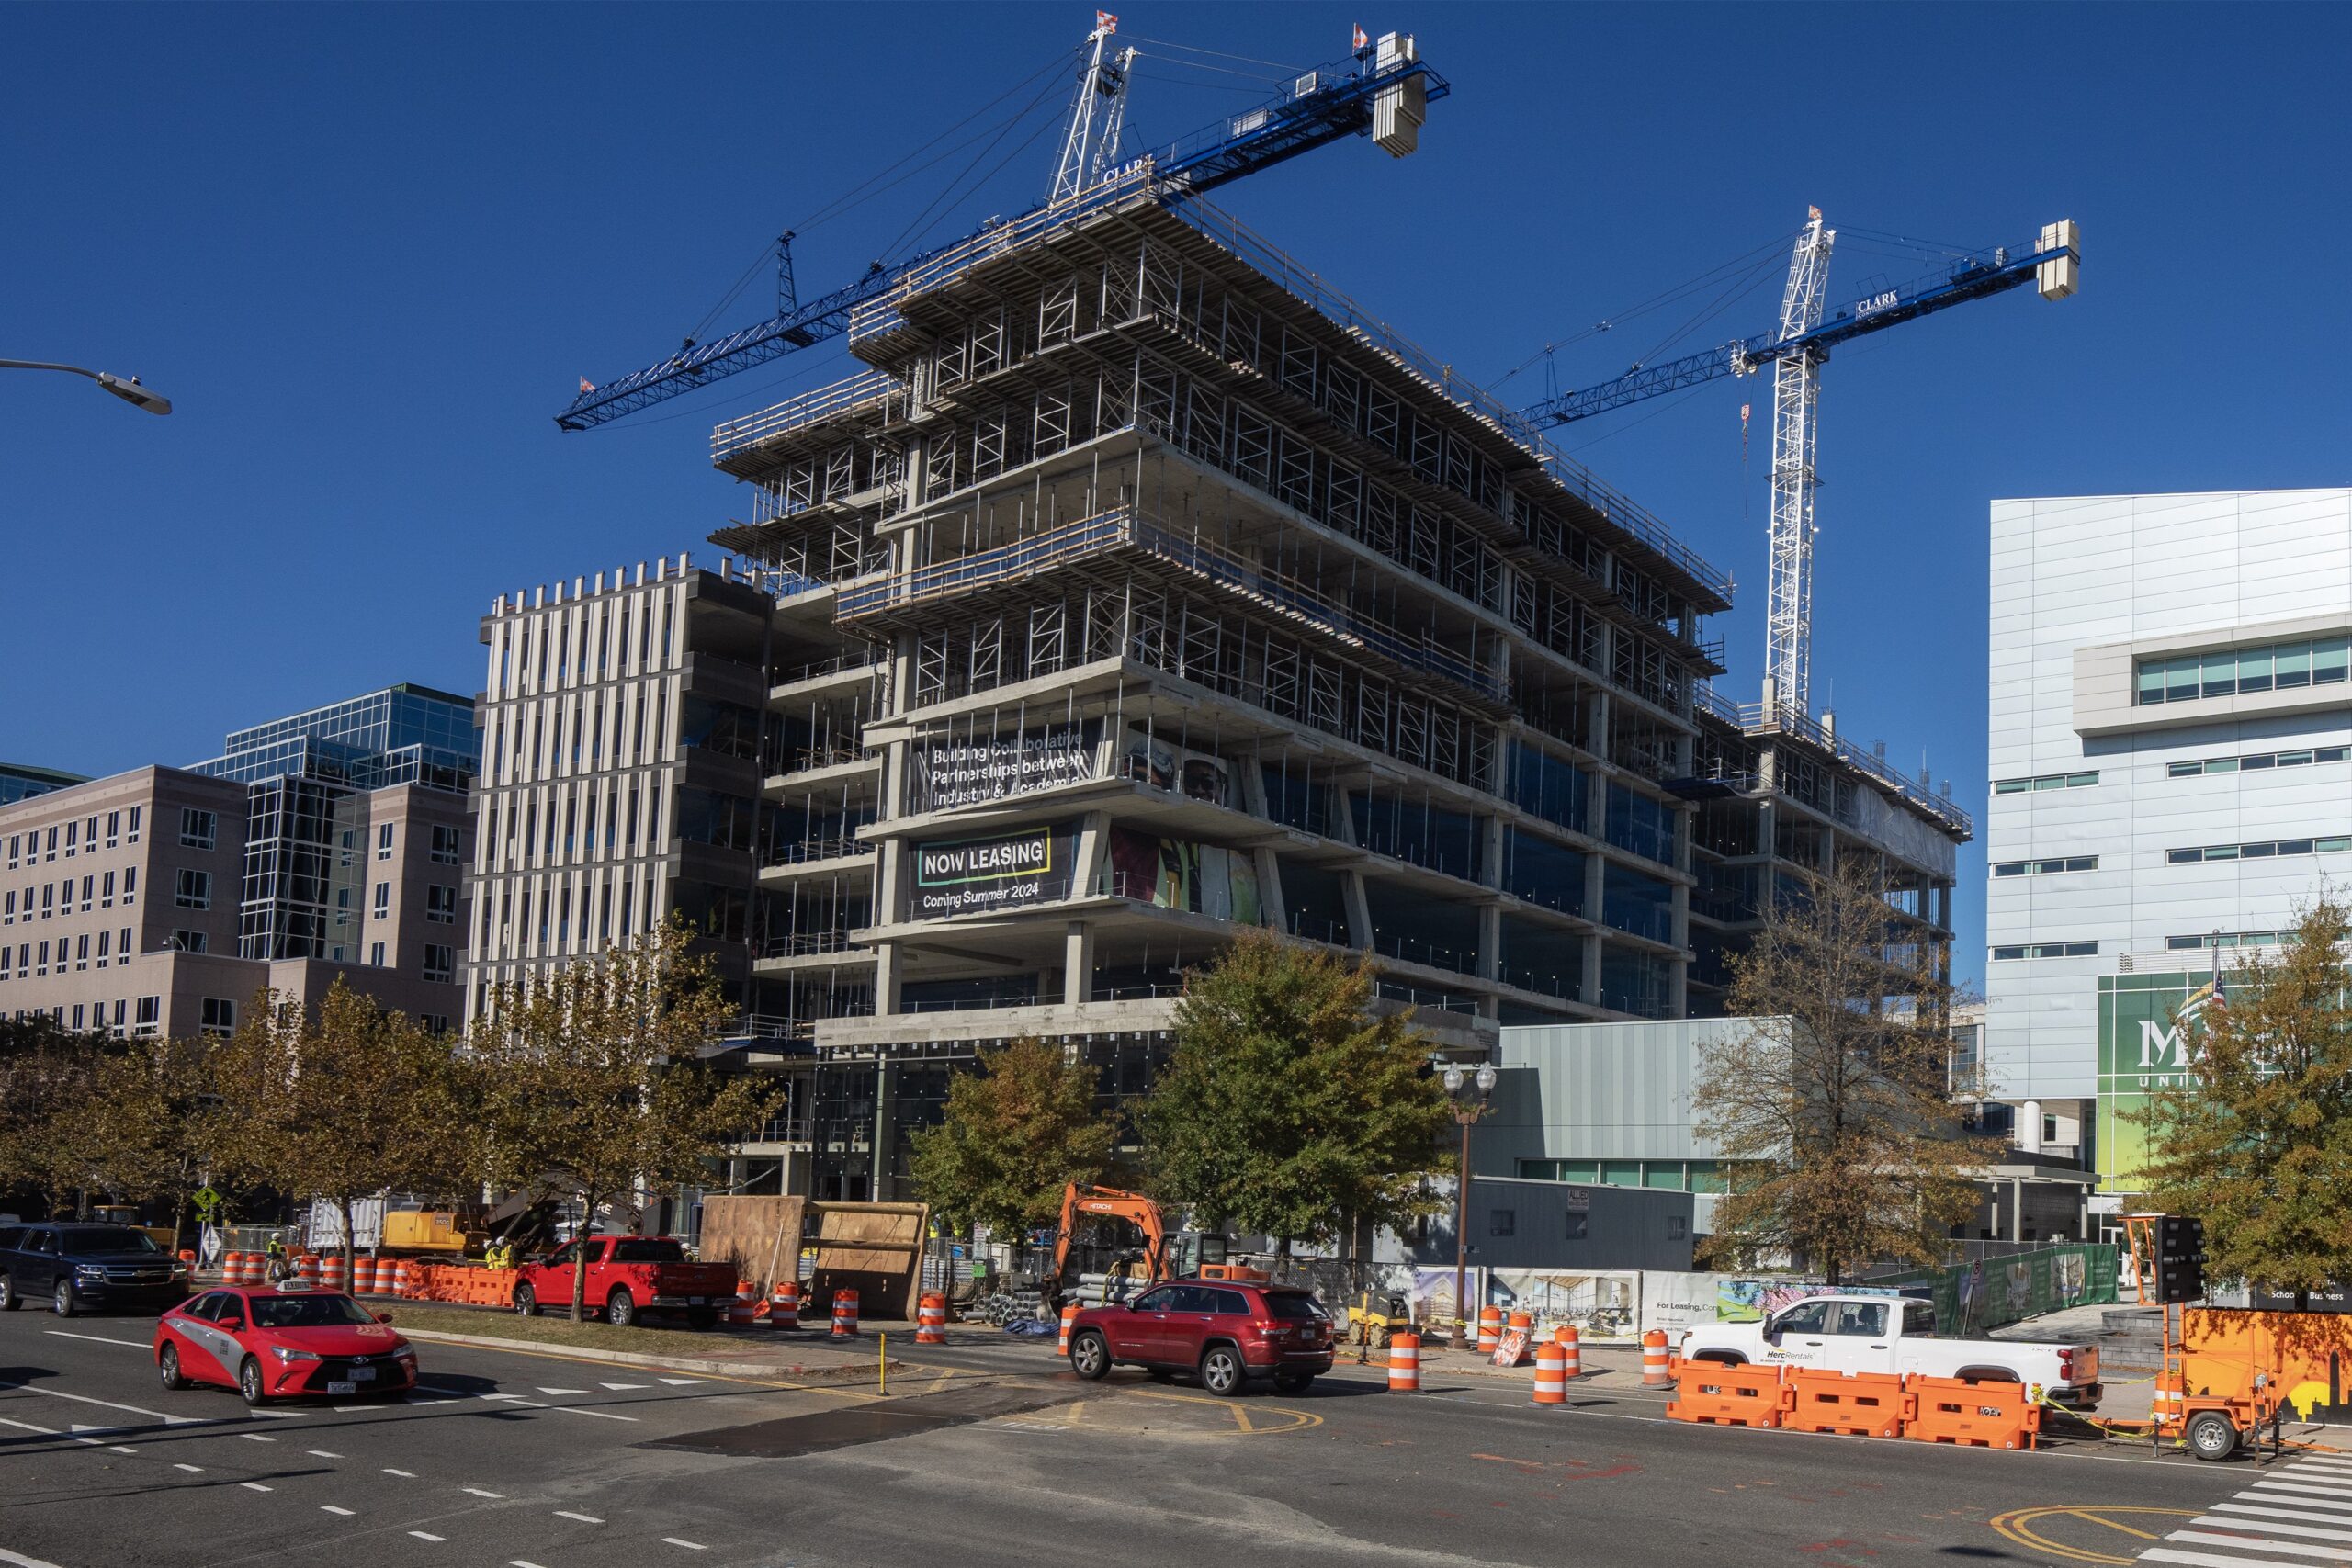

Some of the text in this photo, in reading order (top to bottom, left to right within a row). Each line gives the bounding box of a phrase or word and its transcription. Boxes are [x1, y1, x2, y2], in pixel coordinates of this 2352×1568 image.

[1858, 289, 1898, 313] CLARK
[933, 731, 1084, 764] Building Collaborative
[933, 753, 1084, 784] Partnerships between
[934, 785, 990, 806] Industry
[993, 783, 1005, 798] &
[925, 841, 1043, 874] NOW LEASING
[923, 882, 1039, 908] Coming Summer 2024
[576, 1189, 613, 1215] DRE
[1569, 1190, 1589, 1200] ALLIED
[1671, 1302, 1702, 1313] Leasing,
[2271, 1291, 2344, 1301] Schoo Busness
[1767, 1350, 1814, 1360] HercRentals
